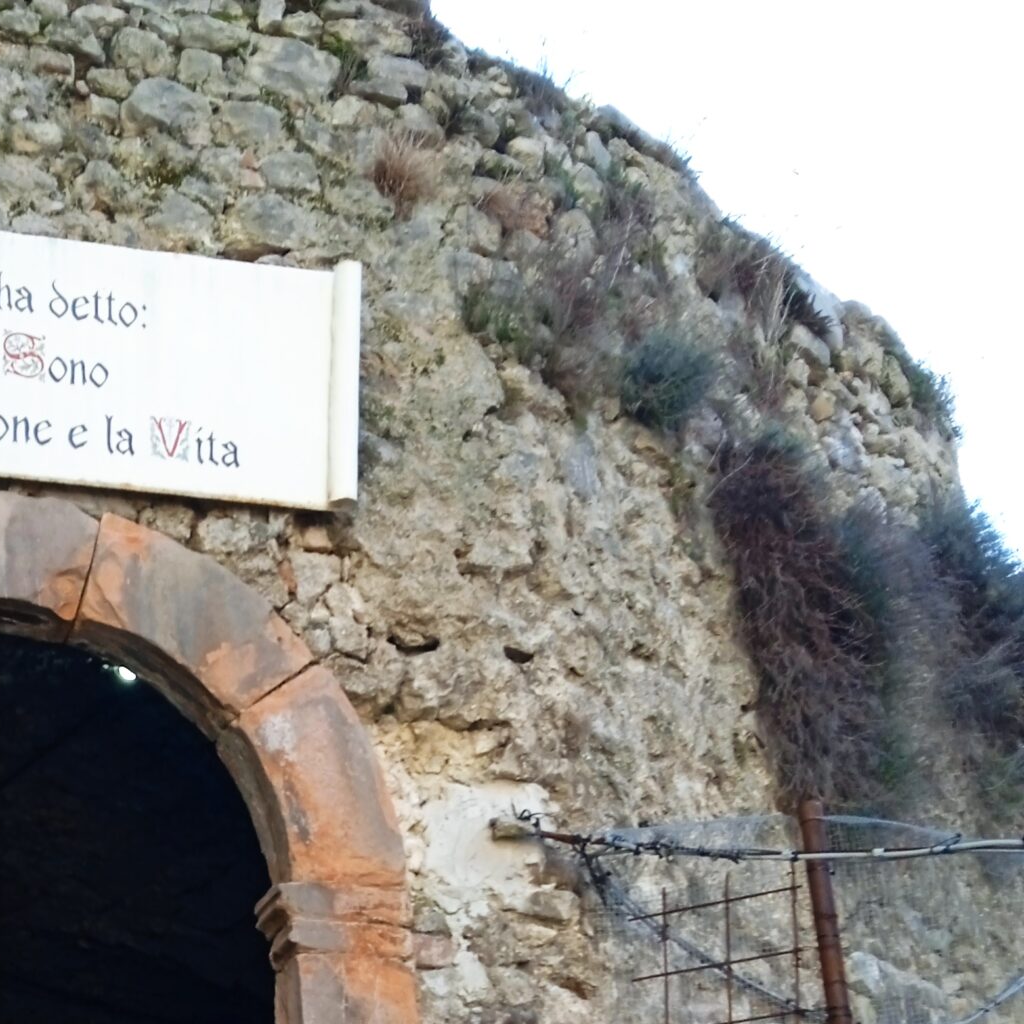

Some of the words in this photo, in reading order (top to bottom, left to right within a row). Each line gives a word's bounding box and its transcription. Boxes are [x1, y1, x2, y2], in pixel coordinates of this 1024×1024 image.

[48, 279, 147, 329] detto:
[2, 329, 109, 388] Sono
[68, 423, 89, 449] e
[105, 414, 135, 456] la
[149, 415, 240, 468] Vita
